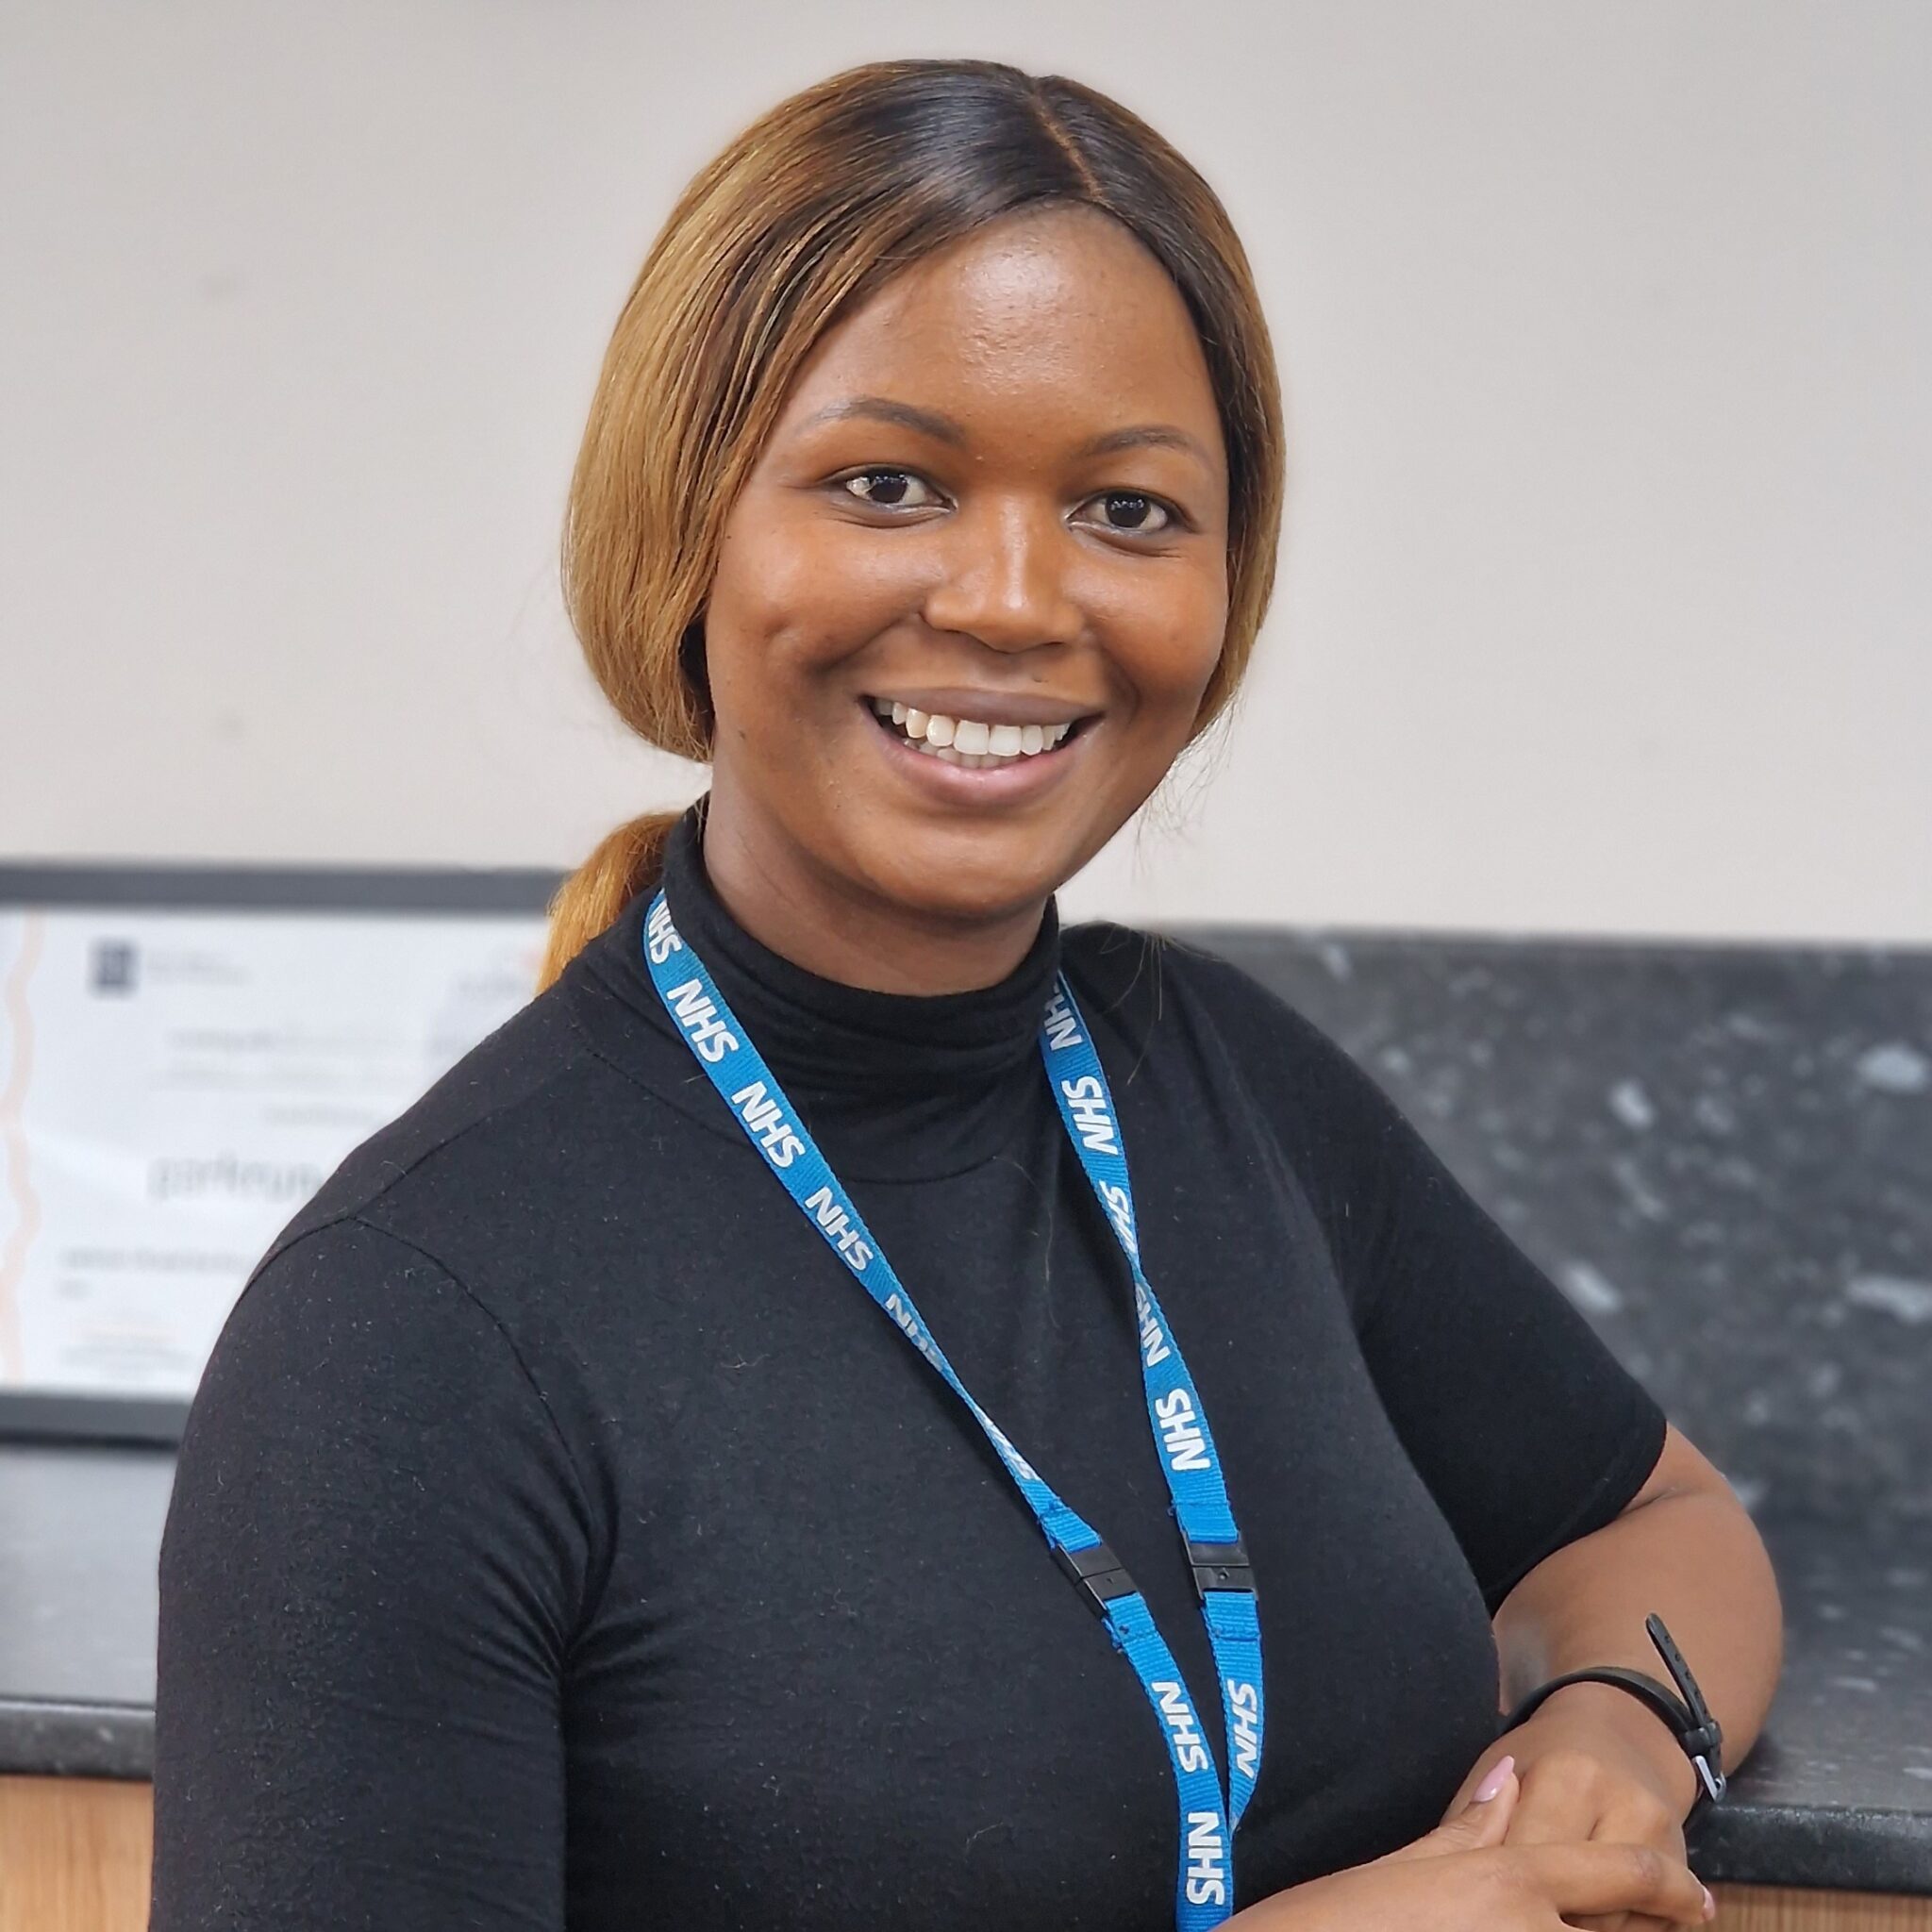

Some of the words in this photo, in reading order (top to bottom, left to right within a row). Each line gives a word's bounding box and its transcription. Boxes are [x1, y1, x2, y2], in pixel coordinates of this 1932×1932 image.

[1043, 982, 1083, 1051] NH
[666, 978, 740, 1062] NHS
[731, 1081, 806, 1169] NHS
[805, 1186, 874, 1271] NHS
[1061, 1075, 1119, 1156] NHS
[1155, 1388, 1211, 1471] NHS
[1227, 1679, 1258, 1779] NHS
[1151, 1681, 1208, 1774] NHS
[1186, 1811, 1225, 1906] NHS
